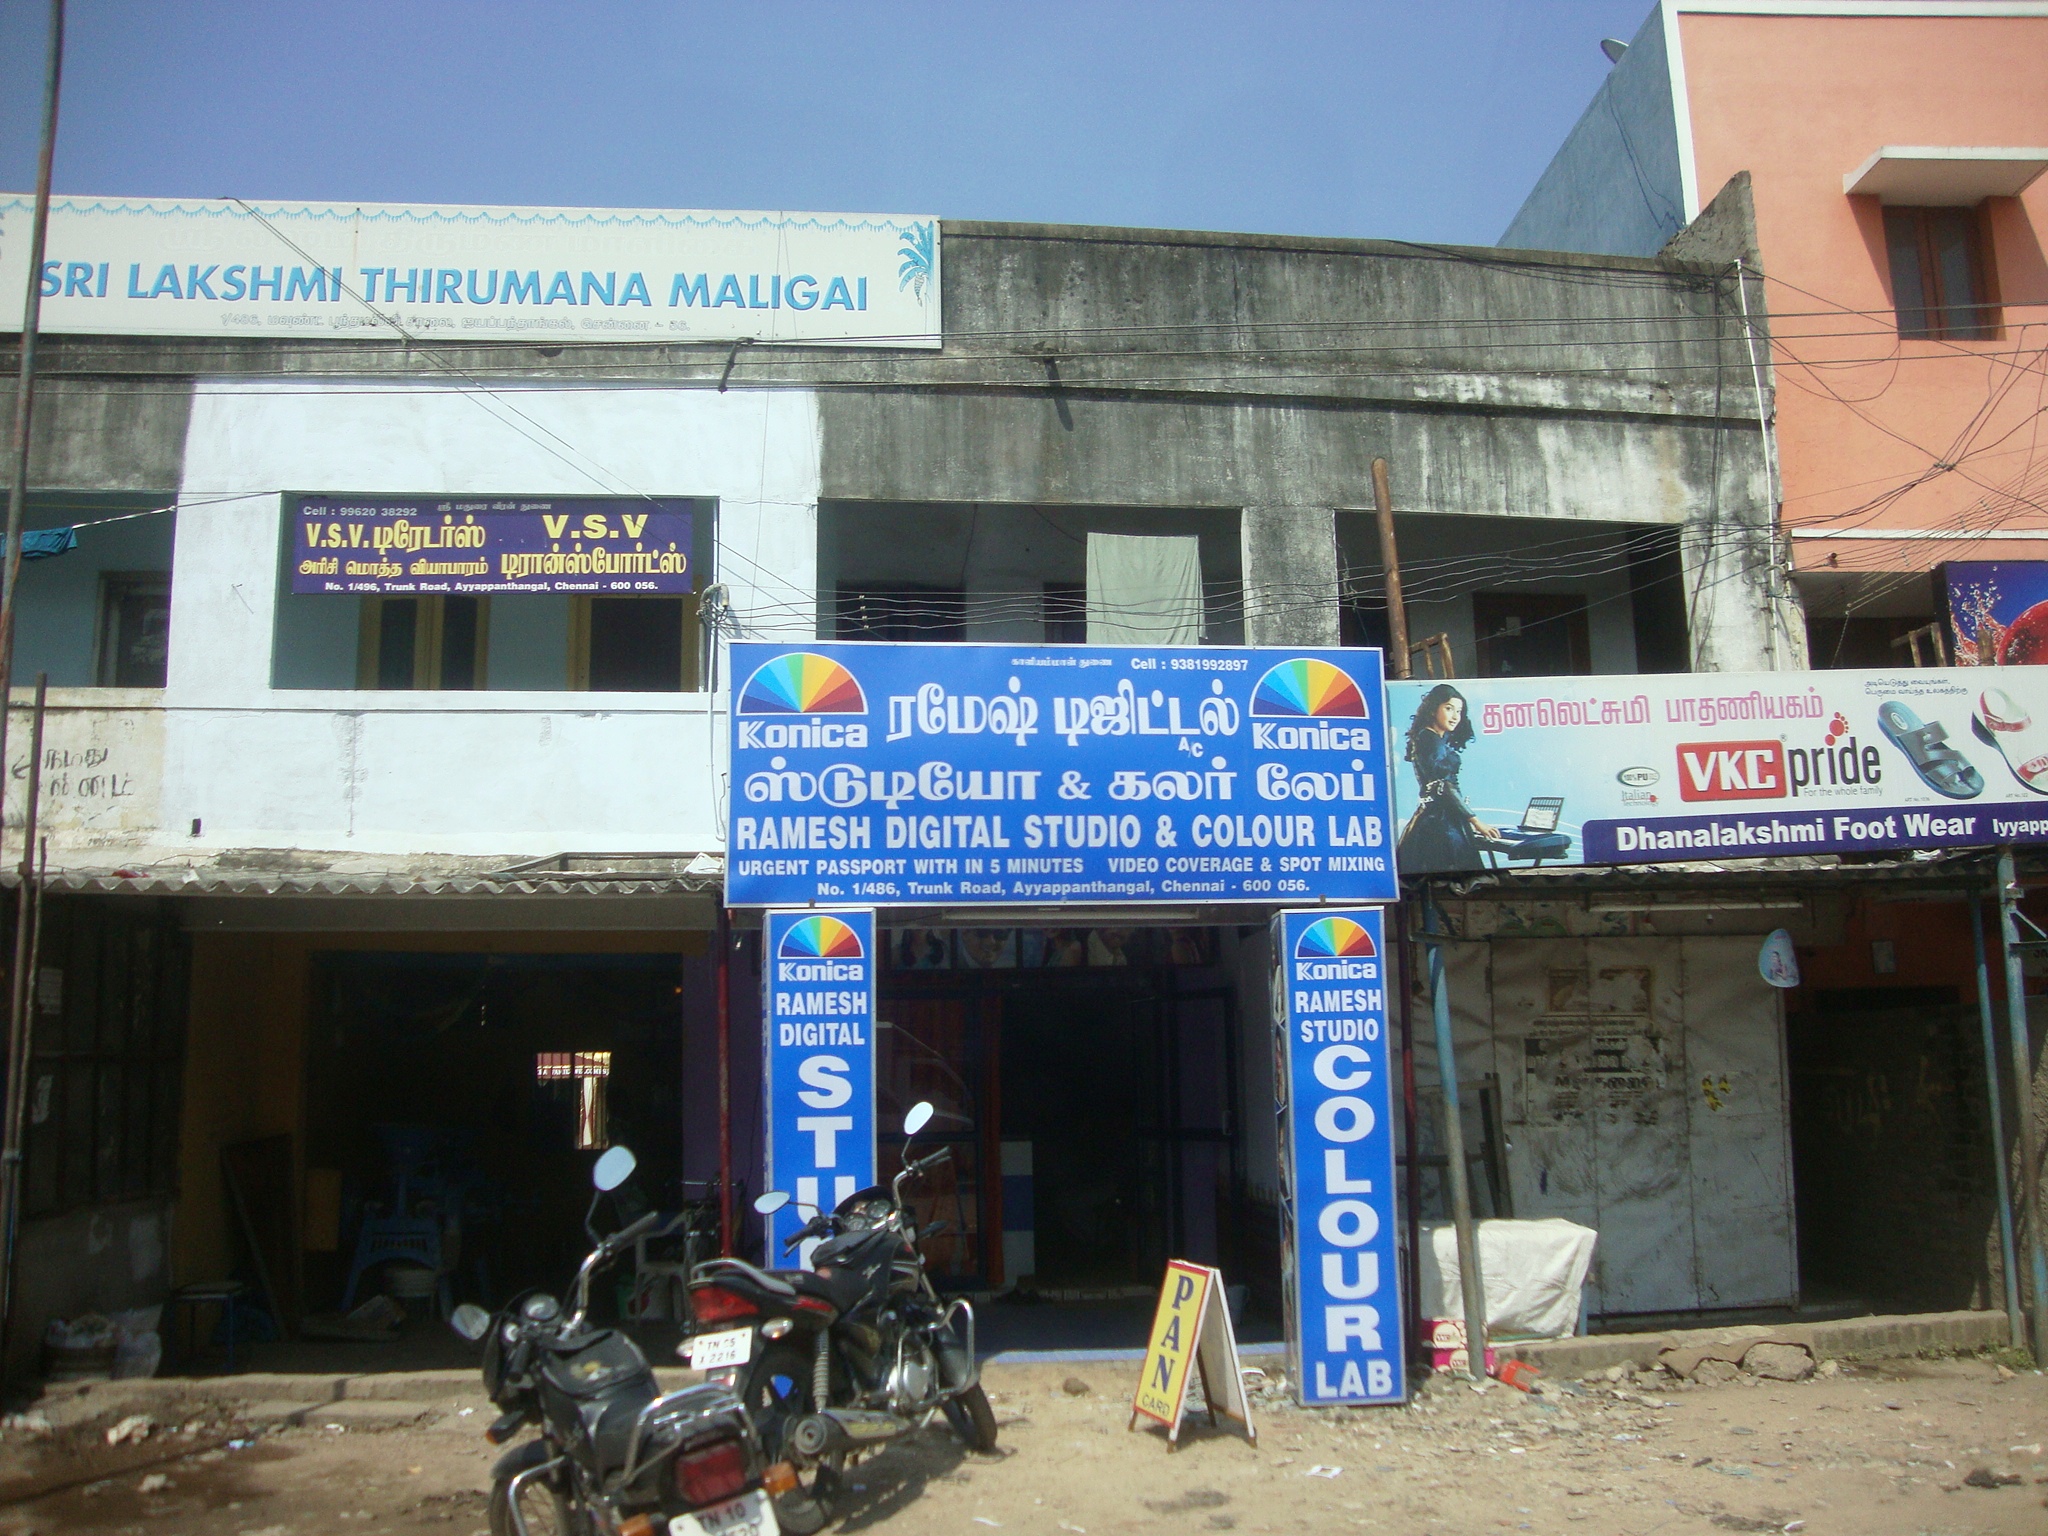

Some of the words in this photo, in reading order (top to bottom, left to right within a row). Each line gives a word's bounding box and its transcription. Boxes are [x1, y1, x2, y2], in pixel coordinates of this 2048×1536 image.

[41, 260, 109, 298] SRI
[127, 263, 343, 302] LAKSHMI
[360, 267, 652, 307] THIRUMANA
[668, 273, 868, 311] MALIGAI
[303, 506, 327, 516] Cell
[340, 507, 377, 516] 99620
[381, 507, 418, 516] 38292
[542, 514, 649, 539] V.S.V
[299, 557, 339, 575] அரிசி
[345, 557, 403, 578] மொத்த
[409, 556, 489, 577] வியாபாரம்
[501, 542, 687, 580] டிரான்ஸ்போர்ட்ஸ்
[325, 582, 344, 591] No.
[348, 582, 381, 592] 1/496,
[384, 582, 416, 591] Trunk
[420, 582, 451, 592] Road,
[455, 581, 551, 592] Ayyappanthangal,
[554, 581, 599, 590] Chennai
[610, 581, 631, 590] 600
[634, 581, 659, 590] 056.
[1130, 658, 1157, 670] Cell
[1170, 658, 1249, 672] 9381992897
[886, 676, 1039, 746] ரமேஷ்
[1054, 678, 1240, 746] டிஜிட்டல்
[1482, 694, 1651, 734] தனலெட்சுமி
[1665, 686, 1824, 727] பாதணியகம்
[738, 718, 868, 749] Konica
[1252, 721, 1371, 751] Konica
[1637, 773, 1649, 781] PU
[1683, 749, 1776, 792] VKC
[1787, 736, 1882, 798] pride
[744, 756, 1042, 810] ஸ்டுடியோ
[1057, 770, 1092, 800] &
[1108, 756, 1238, 801] கலர்
[1256, 758, 1376, 801] லேப்
[1804, 787, 1817, 797] For
[1820, 787, 1833, 797] the
[1834, 786, 1858, 796] whole
[1860, 785, 1883, 797] family
[737, 816, 871, 850] RAMESH
[886, 815, 1010, 849] DIGITAL
[1023, 814, 1142, 848] STUDIO
[1155, 814, 1178, 848] &
[1191, 814, 1316, 848] COLOUR
[1328, 815, 1383, 848] LAB
[1617, 816, 1826, 852] Dhanalakshmi
[1834, 813, 1898, 841] Foot
[1903, 812, 1977, 838] Wear
[738, 860, 809, 876] URGENT
[816, 859, 907, 875] PASSPORT
[914, 859, 958, 875] WITH
[965, 858, 983, 874] IN
[990, 858, 1000, 874] 5
[1007, 857, 1084, 874] MINUTES
[1108, 857, 1160, 873] VIDEO
[1165, 856, 1254, 873] COVERAGE
[1260, 857, 1273, 872] &
[1279, 856, 1322, 872] SPOT
[1328, 856, 1386, 873] MIXING
[817, 882, 845, 896] No.
[852, 882, 901, 898] 1/486,
[907, 881, 953, 895] Trunk
[960, 881, 1006, 897] Road,
[1013, 880, 1156, 898] Ayyappanthangal,
[1161, 879, 1226, 893] Chennai
[1242, 879, 1272, 892] 600
[1277, 879, 1311, 892] 056.
[778, 960, 864, 982] Konica
[1295, 960, 1378, 981] Konica
[776, 991, 868, 1016] RAMESH
[1295, 988, 1383, 1014] RAMESH
[780, 1022, 866, 1047] DIGITAL
[1300, 1018, 1380, 1043] STUDIO
[1313, 1045, 1384, 1353] COLOUR
[1151, 1274, 1195, 1394] PAN
[1315, 1360, 1394, 1399] LAB
